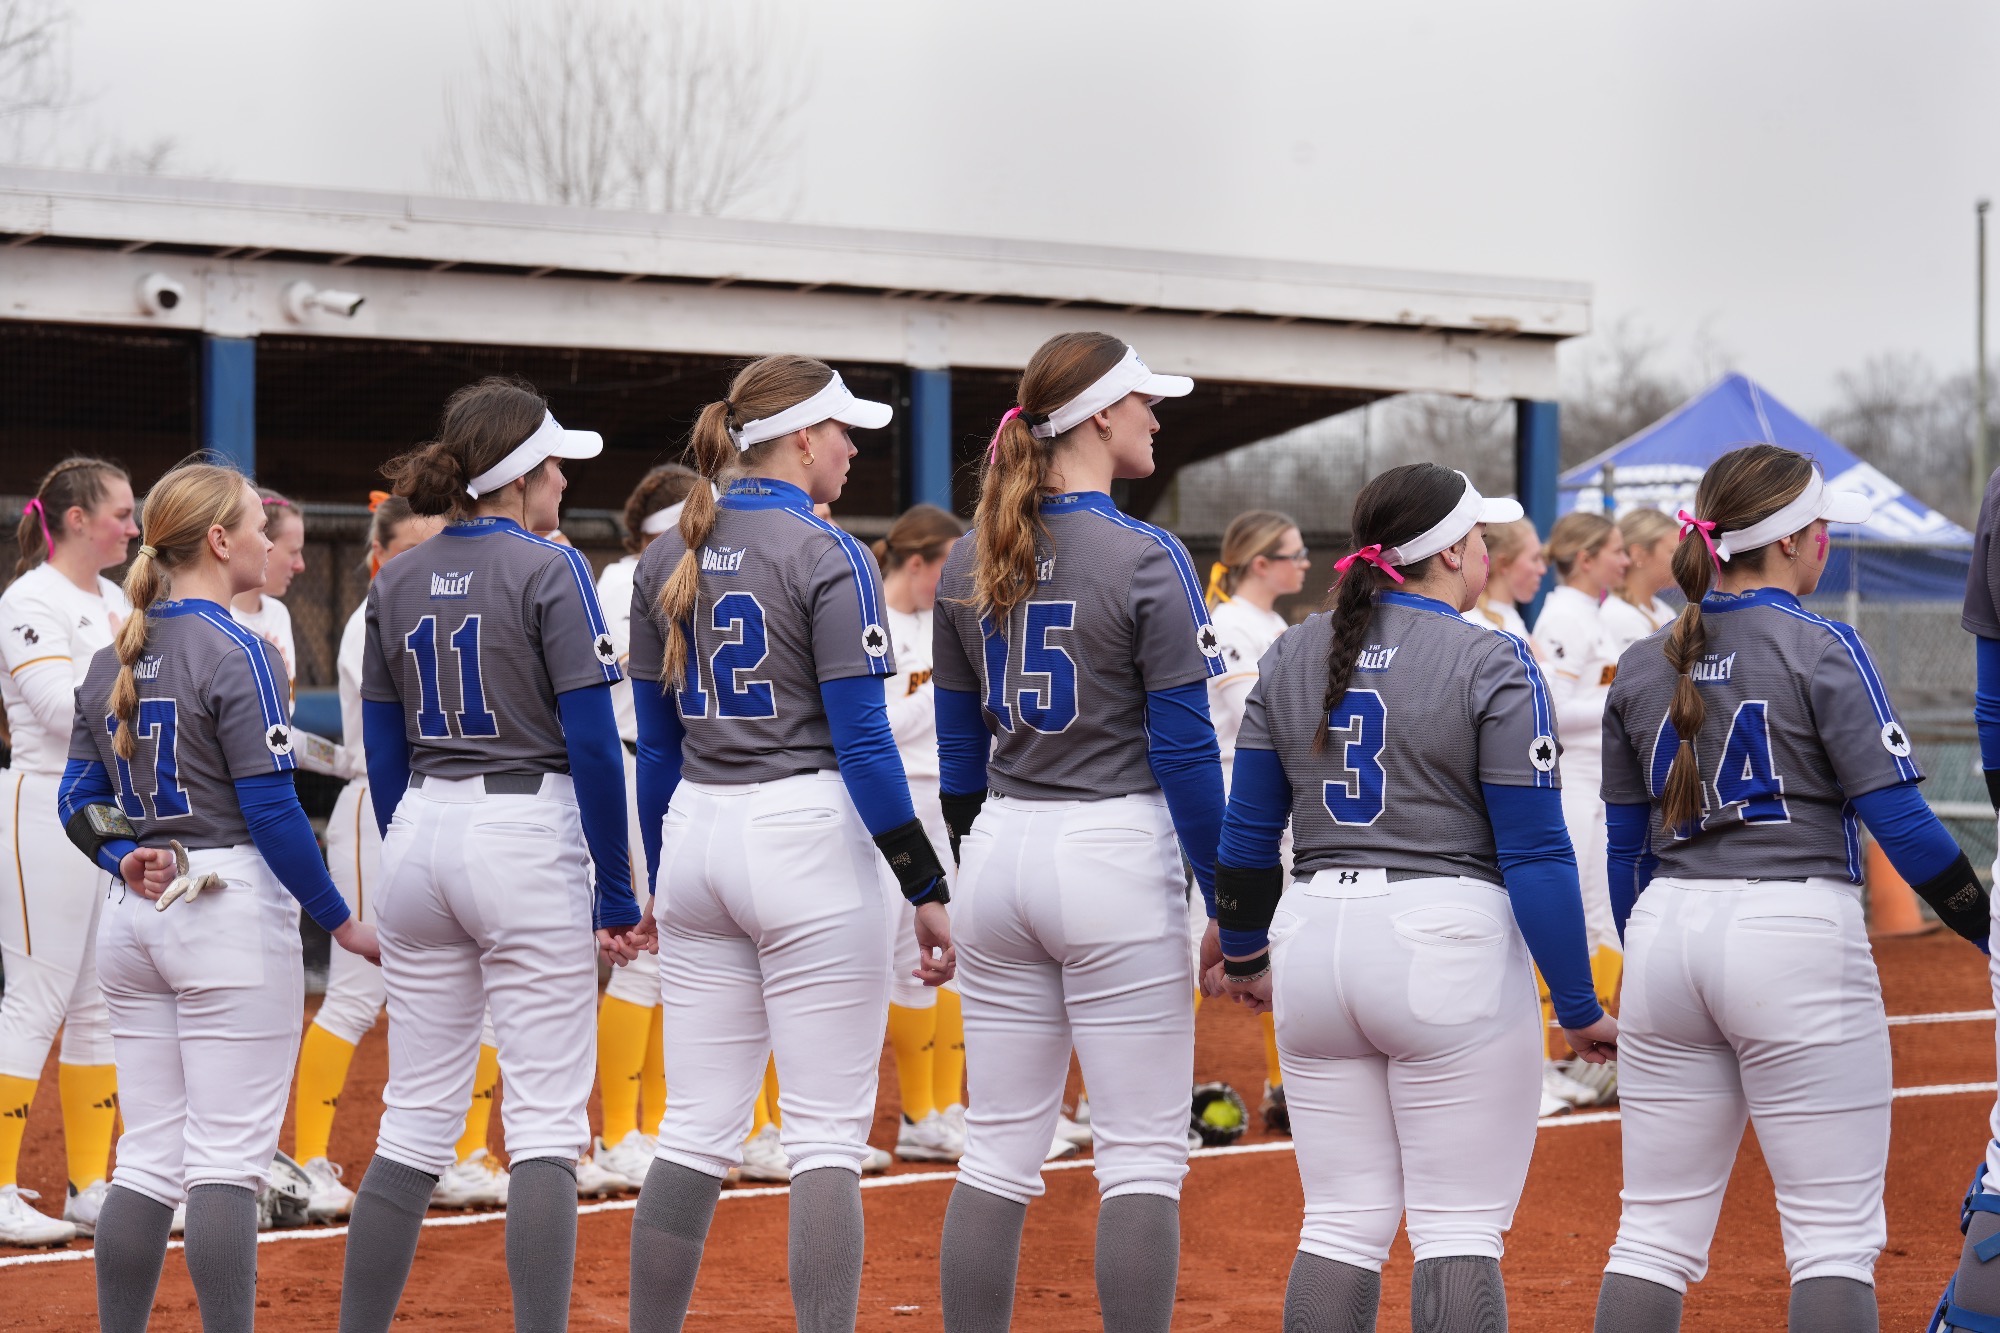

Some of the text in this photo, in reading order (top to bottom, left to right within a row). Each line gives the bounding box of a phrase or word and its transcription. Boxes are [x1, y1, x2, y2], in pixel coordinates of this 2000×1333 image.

[430, 571, 474, 595] VALLEY
[702, 546, 746, 570] VALLEY
[404, 614, 500, 739] 11
[677, 591, 778, 720] 12
[978, 600, 1079, 734] 15
[1355, 645, 1400, 669] ALLEY
[105, 698, 194, 820] 17
[1322, 688, 1387, 826] 3
